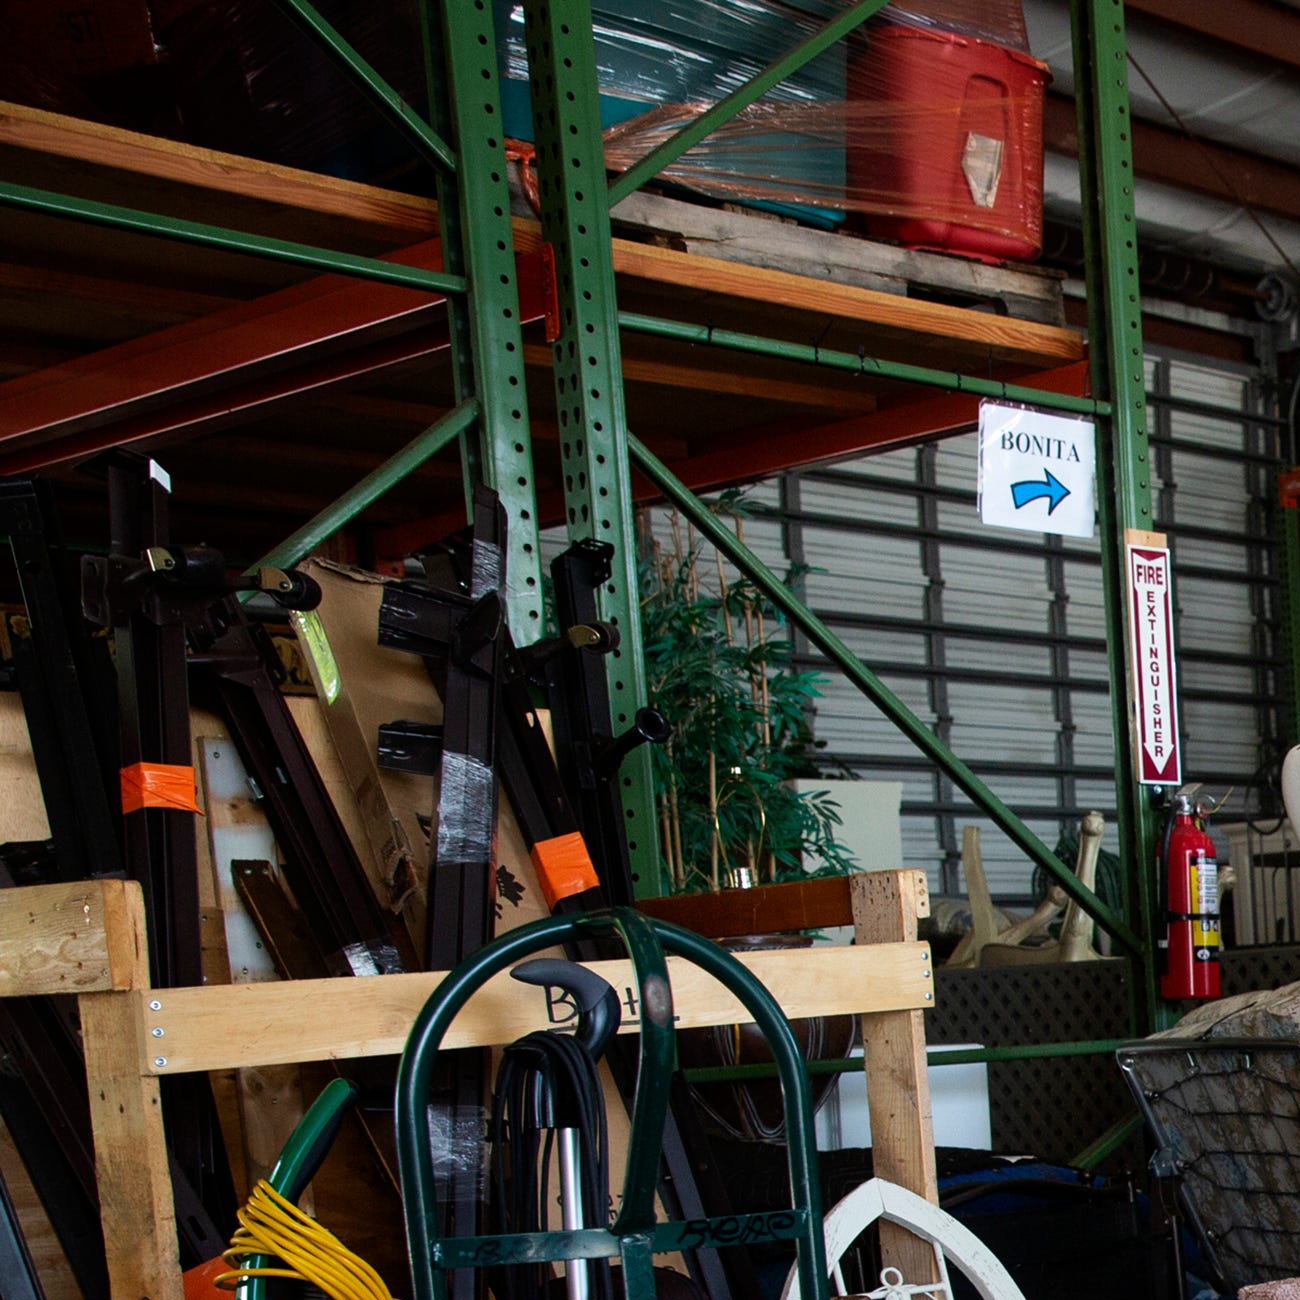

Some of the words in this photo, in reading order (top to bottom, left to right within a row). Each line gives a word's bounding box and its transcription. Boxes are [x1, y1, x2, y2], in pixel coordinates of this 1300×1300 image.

[1001, 430, 1081, 463] BONITA
[1136, 564, 1164, 586] FIRE
[1146, 591, 1164, 758] EXTINGUISHER
